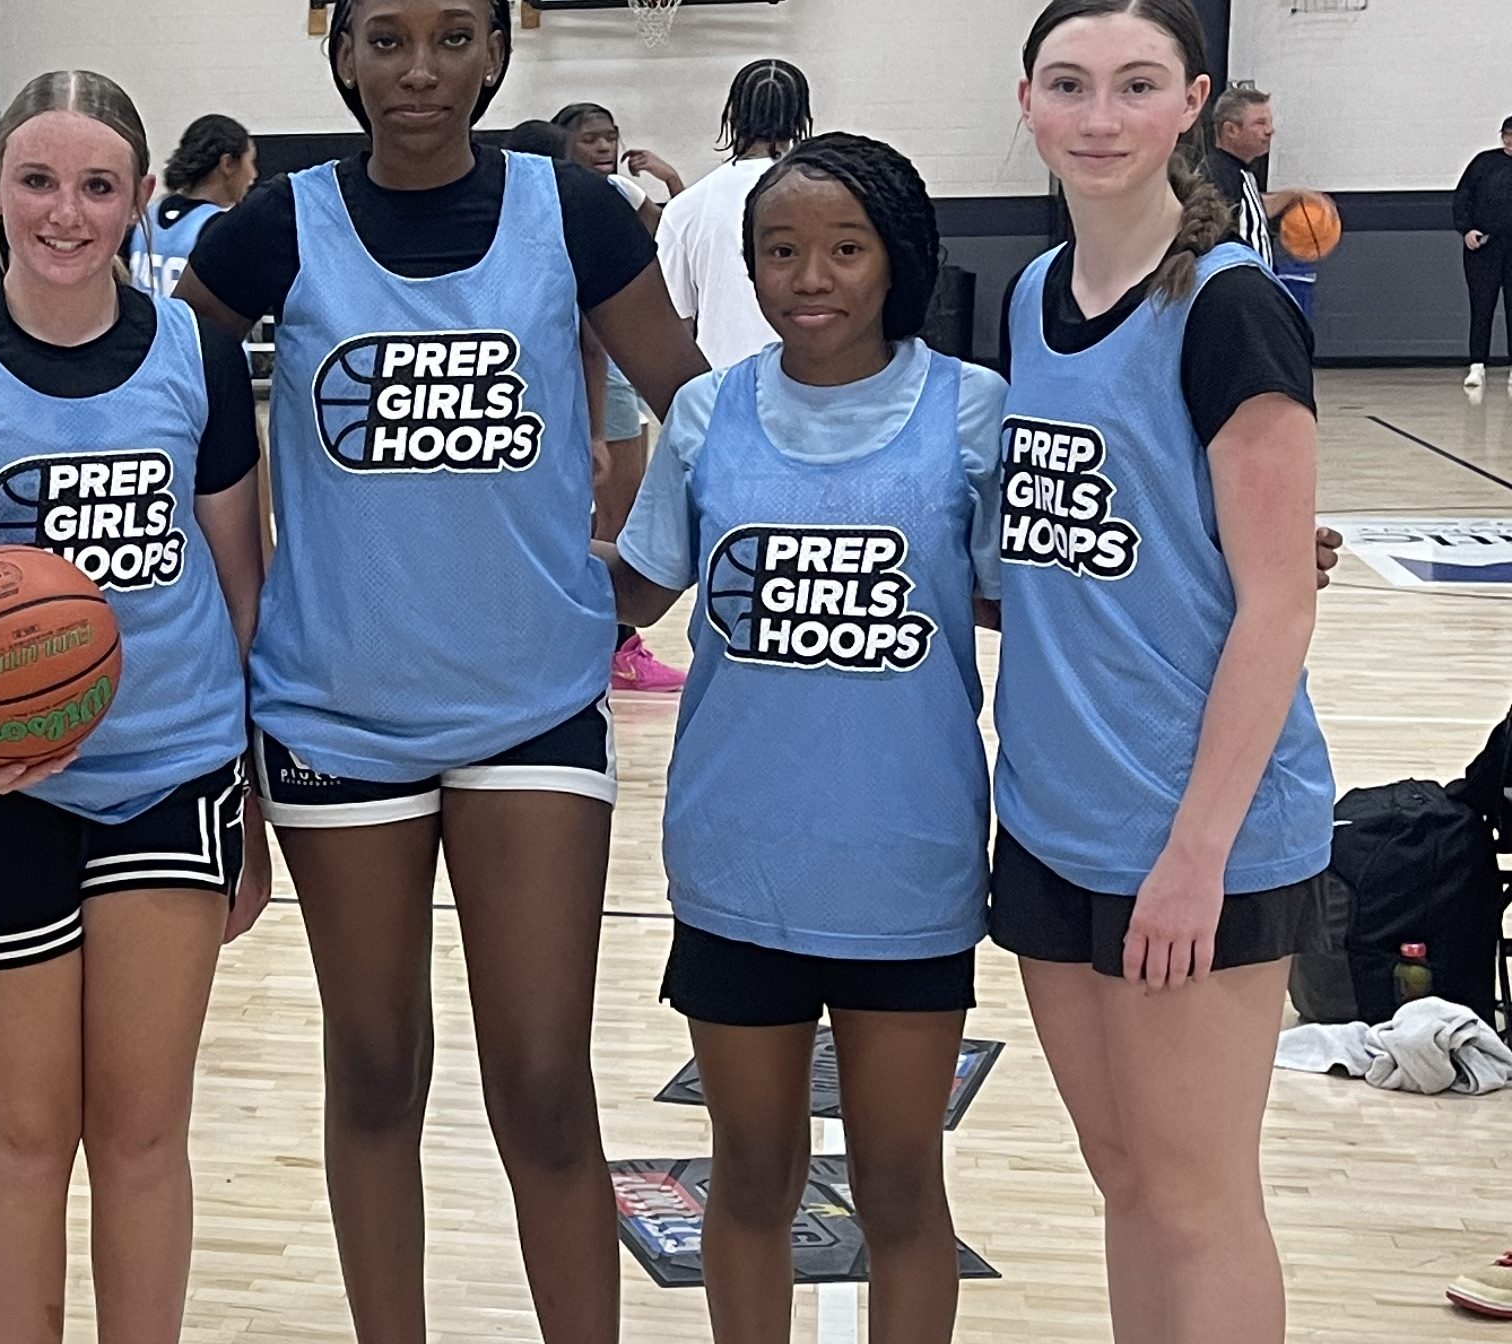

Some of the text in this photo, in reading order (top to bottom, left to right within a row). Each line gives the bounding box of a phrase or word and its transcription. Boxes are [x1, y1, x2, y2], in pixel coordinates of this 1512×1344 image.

[382, 341, 509, 378] PREP
[377, 383, 514, 420] GIRLS
[372, 424, 534, 462] HOOPS
[1013, 427, 1095, 473] PREP
[48, 460, 166, 500] PREP
[1006, 471, 1101, 520] GIRLS
[44, 501, 168, 541] GIRLS
[1002, 514, 1129, 568] HOOPS
[765, 535, 897, 574] PREP
[761, 577, 900, 617] GIRLS
[758, 618, 923, 660] HOOPS
